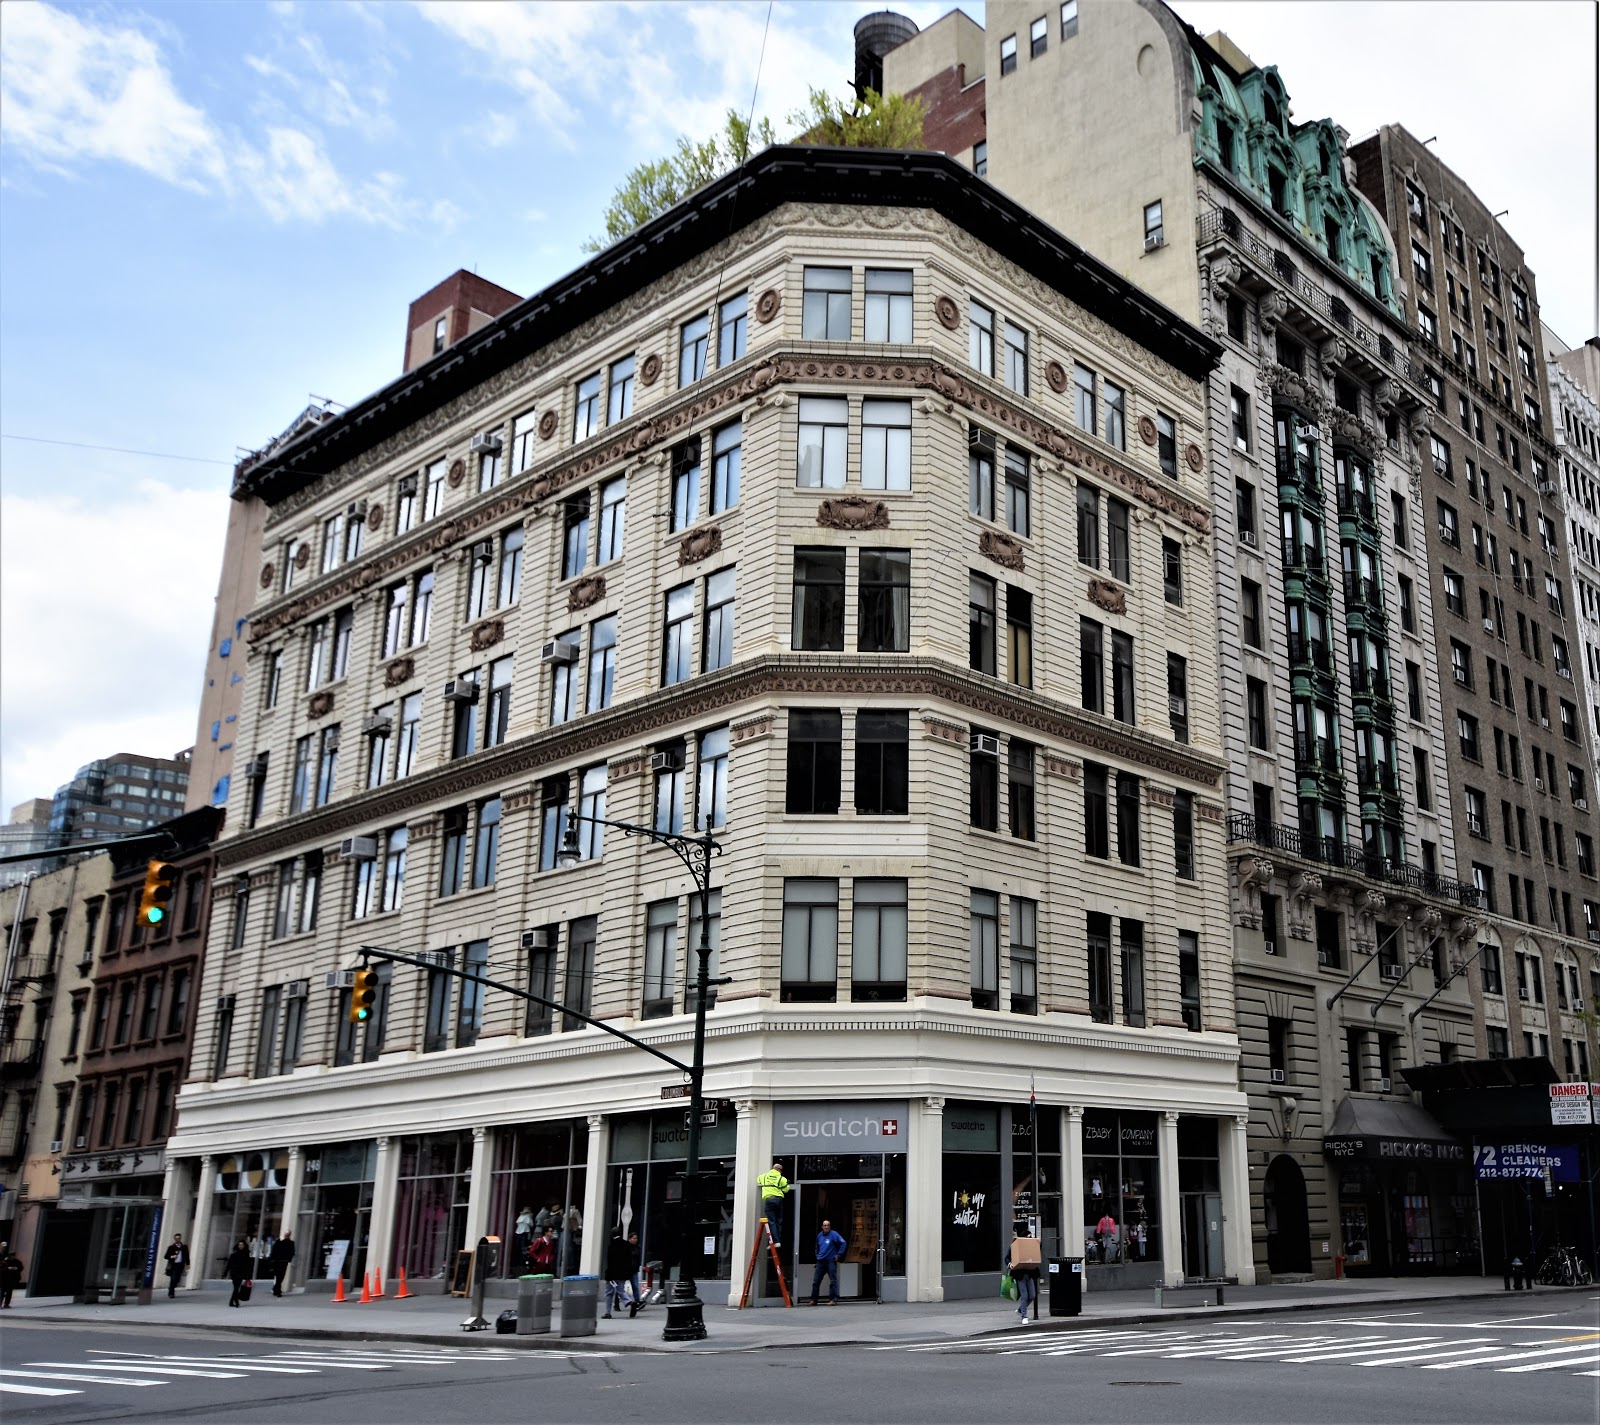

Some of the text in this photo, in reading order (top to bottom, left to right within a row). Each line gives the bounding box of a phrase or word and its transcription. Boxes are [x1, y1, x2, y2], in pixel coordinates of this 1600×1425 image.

[662, 1087, 684, 1099] COLUMBUS
[1551, 1085, 1587, 1096] DANGER
[704, 1100, 711, 1110] W
[711, 1100, 718, 1110] 72
[783, 1117, 879, 1138] swatch
[1085, 1126, 1154, 1140] ZBABY COMPANY
[1325, 1141, 1363, 1150] RICKY'S
[1380, 1141, 1463, 1159] RICKY'S NYC
[1501, 1144, 1546, 1154] FRENCH
[1502, 1156, 1561, 1167] CLEANERS
[1480, 1168, 1544, 1178] 212-873-776
